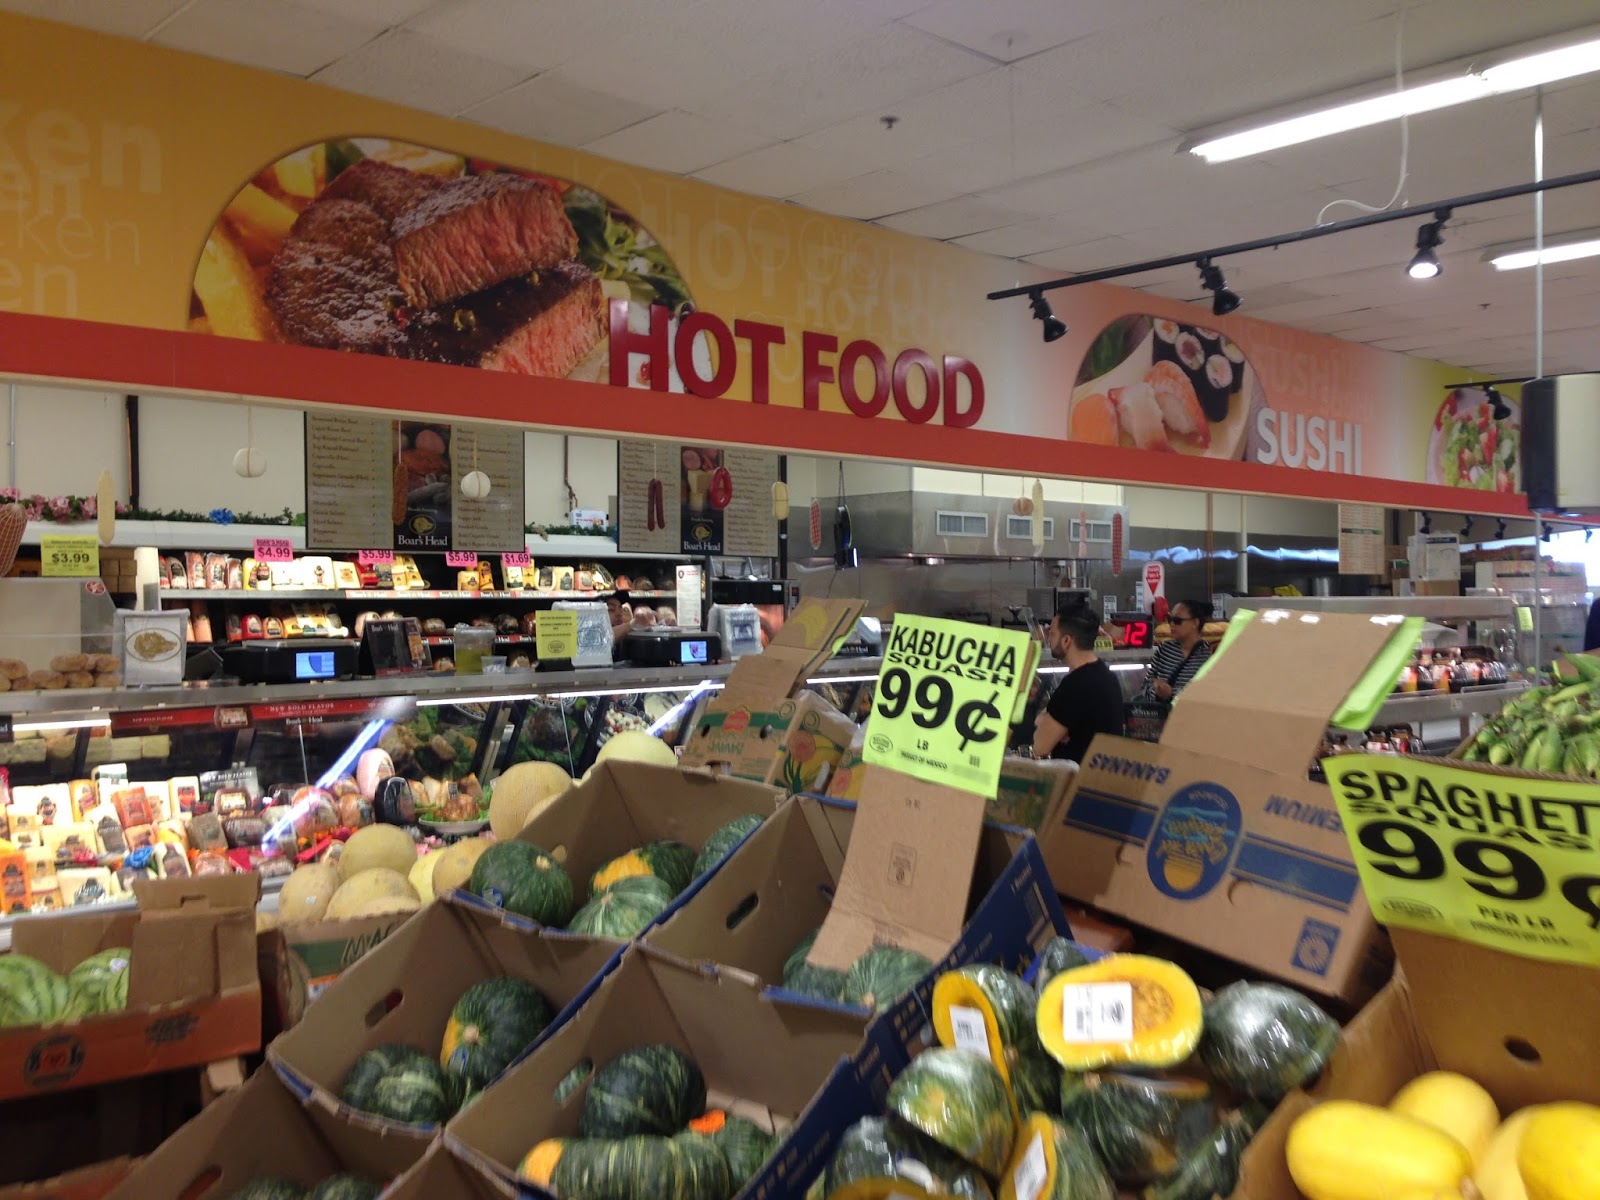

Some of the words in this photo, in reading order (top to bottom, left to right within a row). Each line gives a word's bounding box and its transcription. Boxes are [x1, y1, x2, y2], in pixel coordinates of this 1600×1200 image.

[608, 297, 786, 405] HOT
[803, 331, 985, 428] FOOD
[1256, 407, 1363, 475] SUSHI
[398, 535, 423, 545] Boar's
[425, 535, 448, 546] Head
[703, 541, 721, 551] Head
[51, 553, 90, 564] $3.99
[257, 546, 290, 558] $4.99
[362, 549, 391, 559] $5.99
[448, 551, 475, 562] $5.99
[504, 553, 529, 563] $1.69
[1124, 621, 1147, 645] 12
[890, 625, 1016, 675] KABUCHA
[887, 652, 1014, 688] SQUASH
[917, 738, 930, 750] LB
[1088, 752, 1171, 785] BANANAS
[1264, 794, 1344, 834] EMIUM
[1477, 904, 1520, 926] PER
